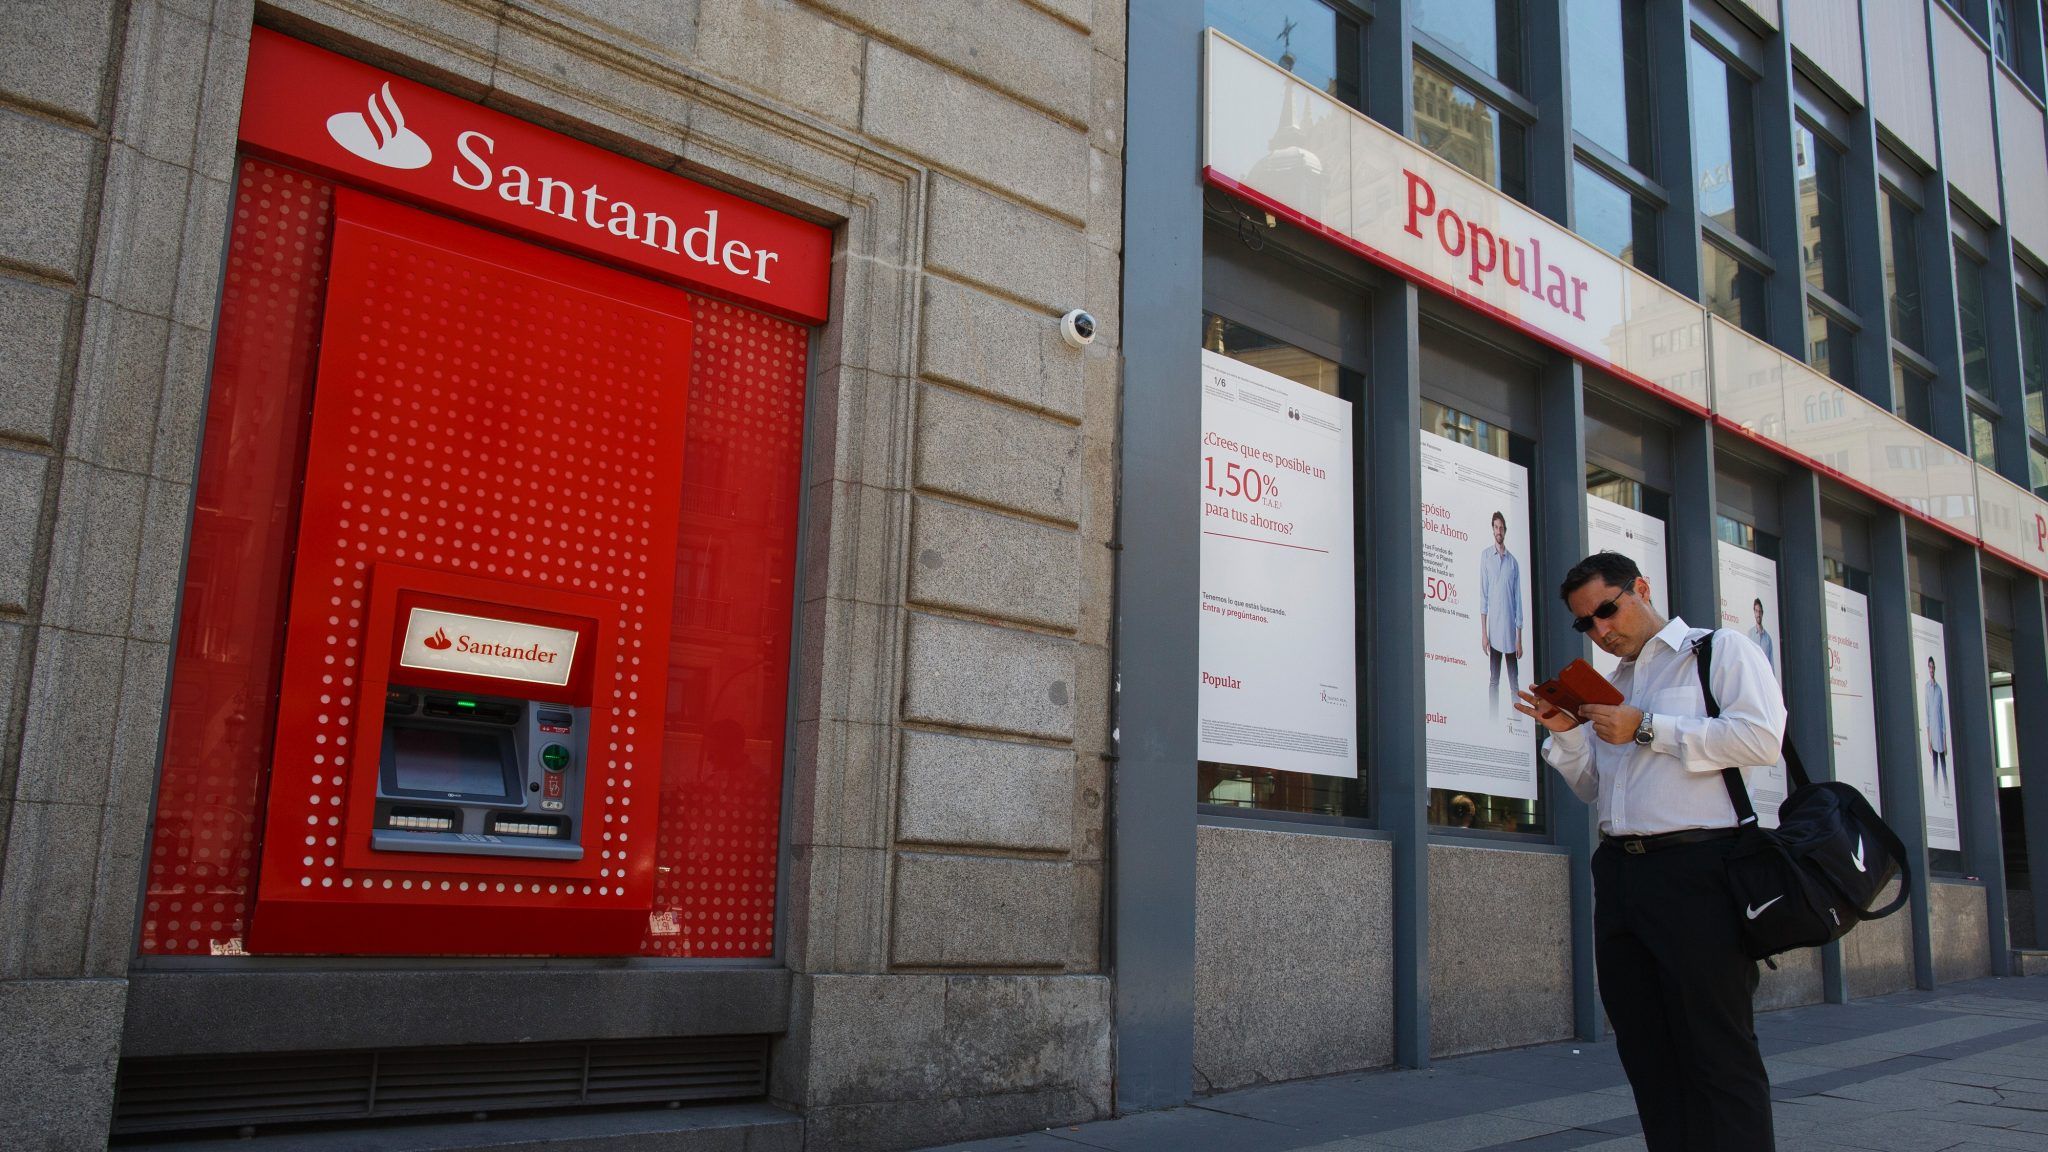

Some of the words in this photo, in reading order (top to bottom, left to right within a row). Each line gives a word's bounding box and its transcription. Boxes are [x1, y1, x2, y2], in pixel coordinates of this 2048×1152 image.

[451, 129, 779, 284] Santander
[1402, 168, 1588, 322] Popular
[1204, 431, 1239, 452] ¿Crees
[1240, 444, 1260, 459] que
[1262, 451, 1273, 463] es
[1275, 455, 1311, 475] posible
[1313, 466, 1326, 479] un
[1204, 456, 1279, 503] 1,50%
[1205, 502, 1229, 519] para
[1231, 507, 1248, 524] tus
[1250, 512, 1294, 535] ahorros?
[1440, 523, 1469, 542] Ahorro
[1202, 591, 1227, 604] Tenemos
[1227, 596, 1233, 605] lo
[1234, 600, 1244, 608] que
[1245, 602, 1260, 611] estás
[1202, 602, 1221, 613] Entra
[1221, 608, 1226, 616] y
[1226, 609, 1269, 624] pregúntanos.
[456, 634, 558, 664] Santander
[1202, 671, 1242, 689] Popular
